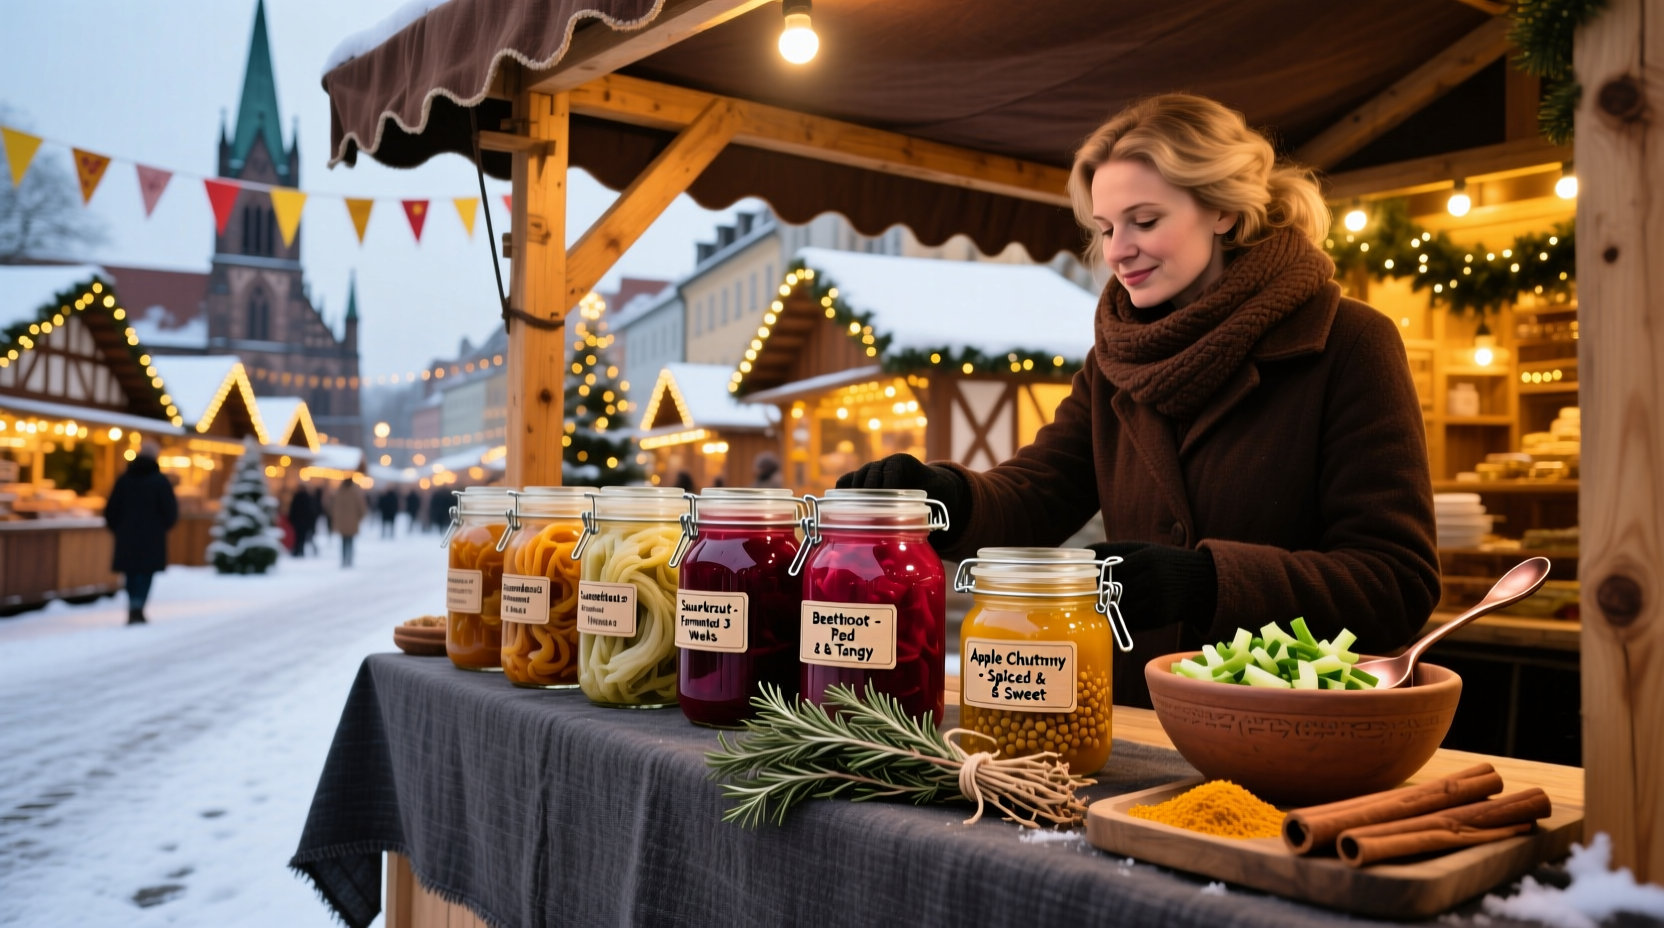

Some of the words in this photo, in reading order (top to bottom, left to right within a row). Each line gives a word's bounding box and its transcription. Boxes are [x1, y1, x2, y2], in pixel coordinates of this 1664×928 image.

[834, 643, 874, 662] Tangy
[970, 647, 1002, 669] Apple
[987, 669, 1031, 687] Spiced
[1035, 672, 1046, 685] &
[1004, 686, 1047, 701] Sweet
